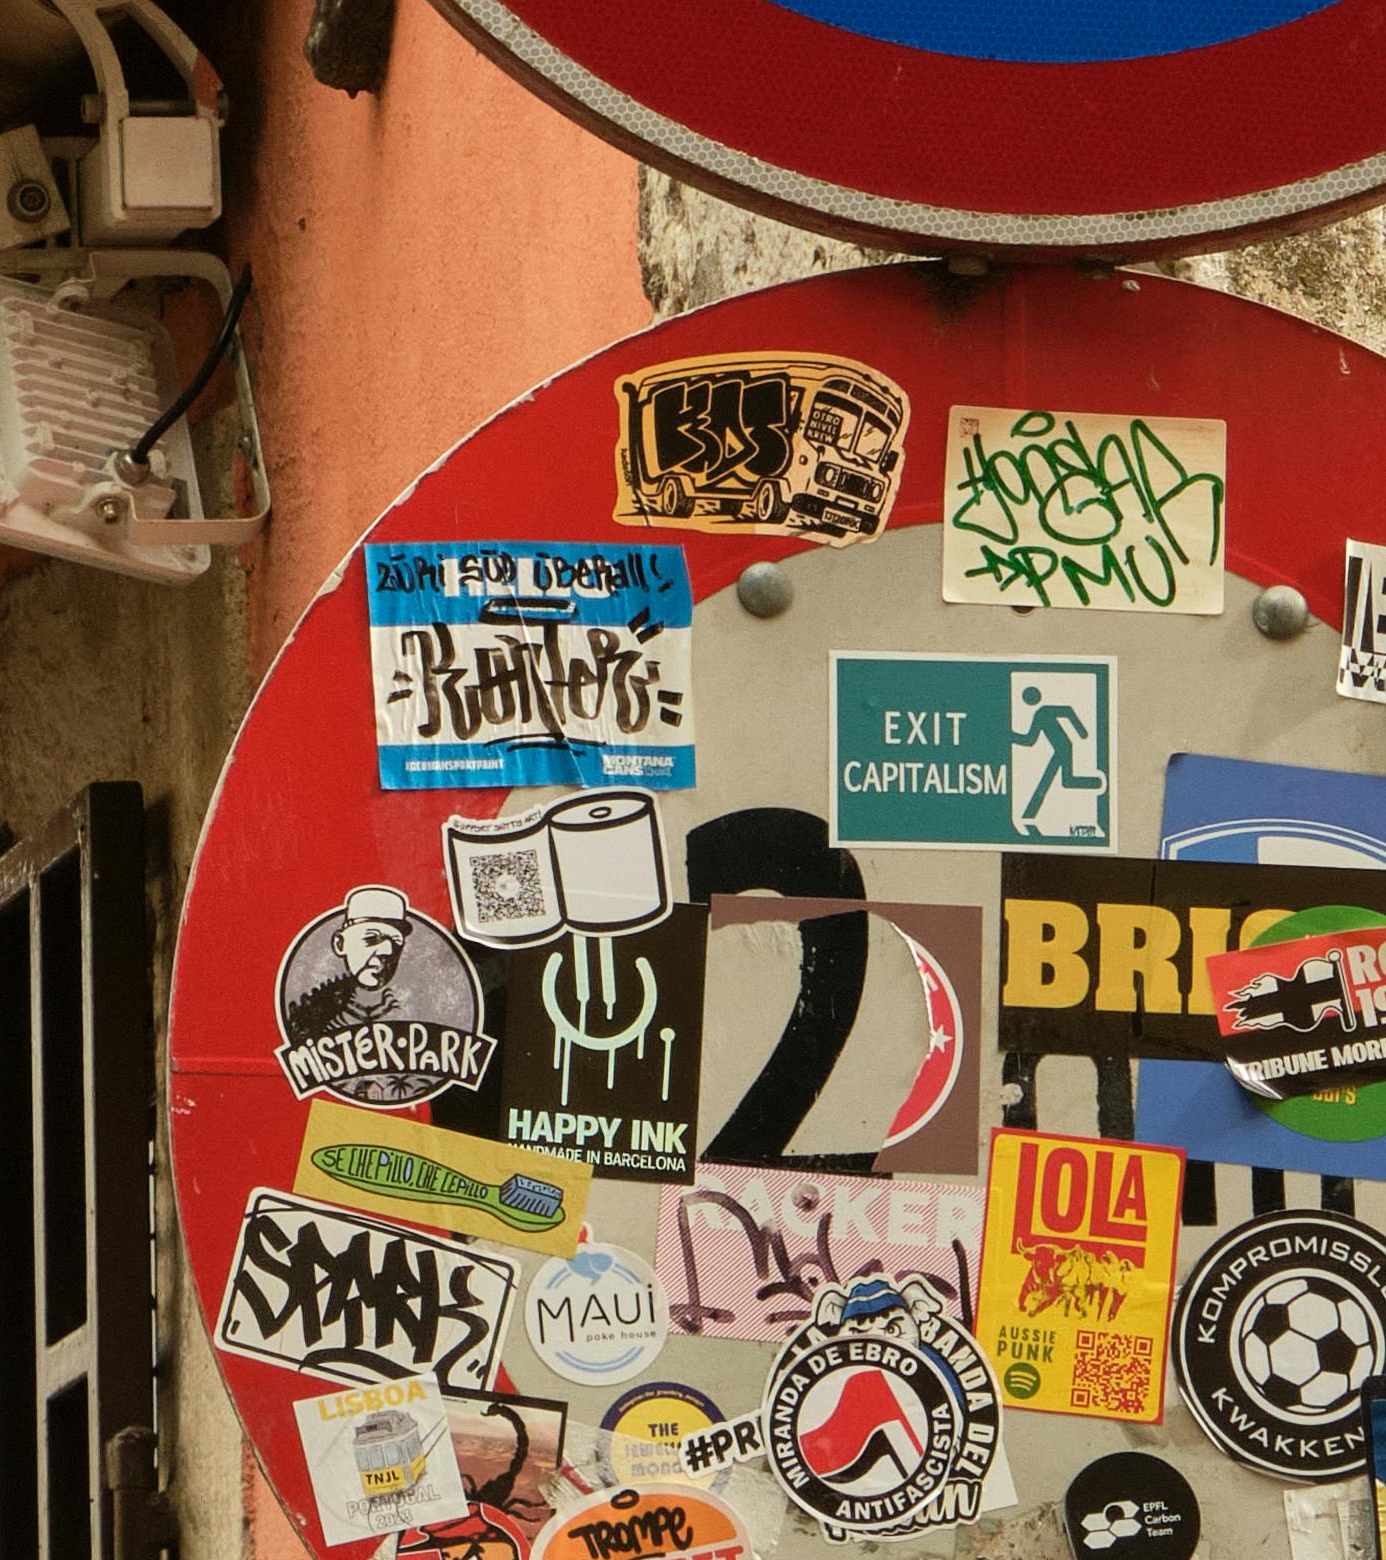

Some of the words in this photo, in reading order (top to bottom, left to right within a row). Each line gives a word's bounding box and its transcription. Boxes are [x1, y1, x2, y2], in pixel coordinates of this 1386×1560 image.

[883, 711, 968, 747] EXIT
[843, 760, 1009, 797] CAPITALISM
[1241, 1044, 1330, 1084] TRIBUNE
[507, 1108, 622, 1148] HAPPY
[630, 1118, 690, 1155] INK
[321, 1147, 348, 1172] SE
[585, 1148, 602, 1164] IN
[603, 1150, 687, 1172] BARCELONA
[1011, 1142, 1148, 1268] LOLA
[996, 1339, 1056, 1363] PUNK
[998, 1326, 1057, 1343] AUSSIE
[920, 1312, 993, 1413] BANDA
[317, 1379, 428, 1422] LISBOA
[774, 1375, 811, 1489] MIRANDA
[807, 1346, 844, 1377] DE
[849, 1342, 919, 1377] EBRO
[648, 1423, 680, 1438] THE
[835, 1402, 953, 1521] ANTIFASCISTA
[954, 1422, 996, 1478] DEL
[365, 1470, 400, 1486] TNJL
[1143, 1501, 1169, 1513] EPFL
[1144, 1513, 1181, 1525] Carbon
[1146, 1527, 1173, 1537] Team
